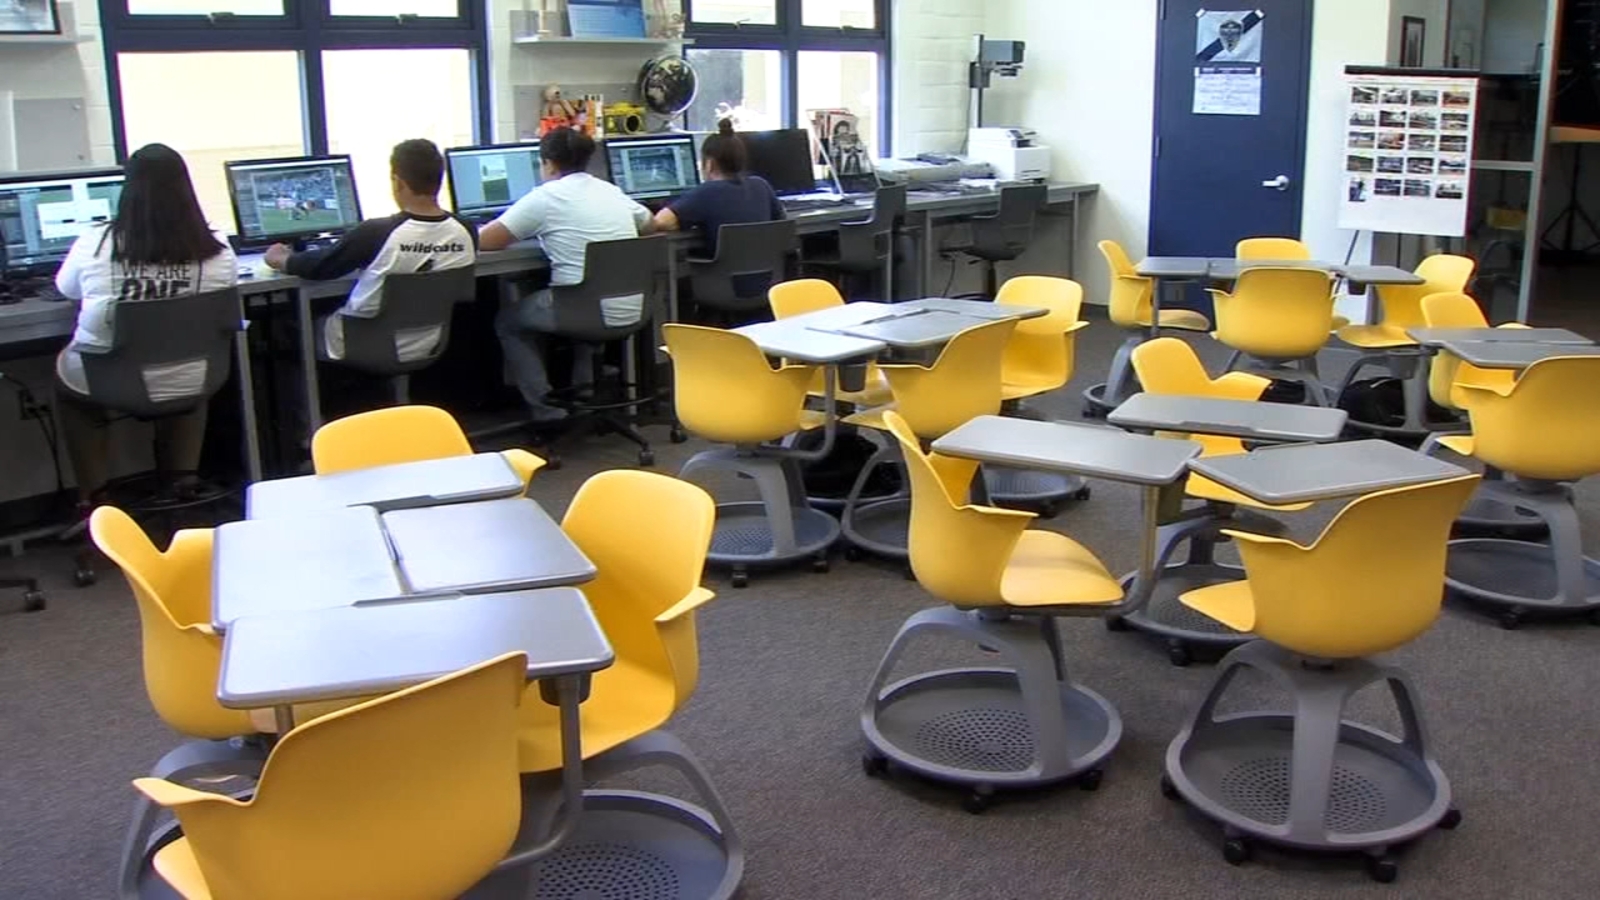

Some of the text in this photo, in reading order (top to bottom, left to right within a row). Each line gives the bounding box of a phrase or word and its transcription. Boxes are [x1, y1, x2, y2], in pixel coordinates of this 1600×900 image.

[399, 241, 465, 253] wildcats
[121, 260, 191, 280] WE ARE
